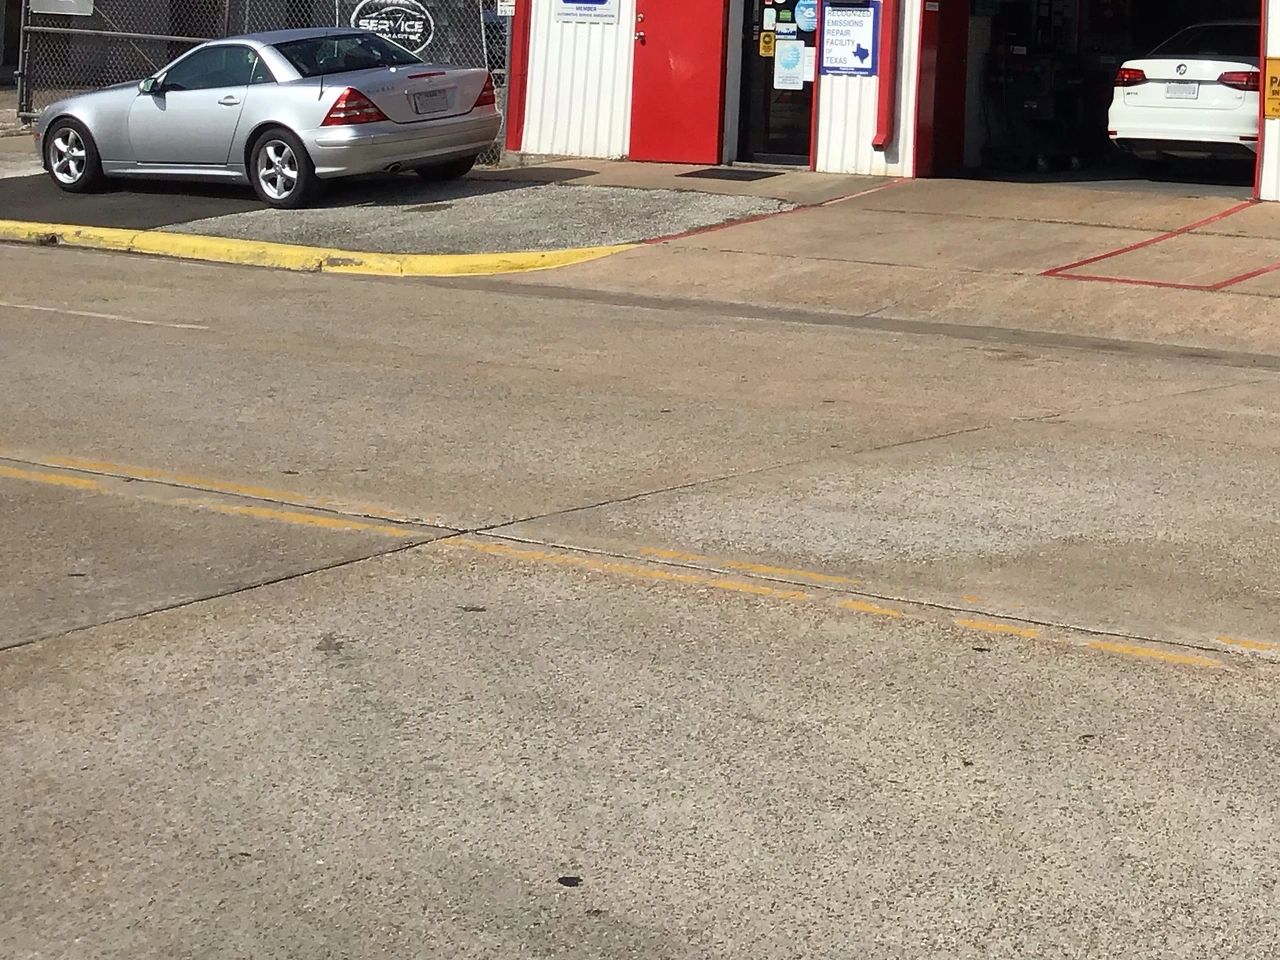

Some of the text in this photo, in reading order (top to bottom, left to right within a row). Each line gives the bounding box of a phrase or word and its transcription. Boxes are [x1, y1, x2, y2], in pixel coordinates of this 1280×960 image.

[358, 16, 424, 33] SERVICE
[826, 19, 864, 27] EMISSIONS
[826, 28, 851, 36] REPAIR
[826, 38, 855, 47] FACILITY
[825, 56, 848, 65] TEXAS
